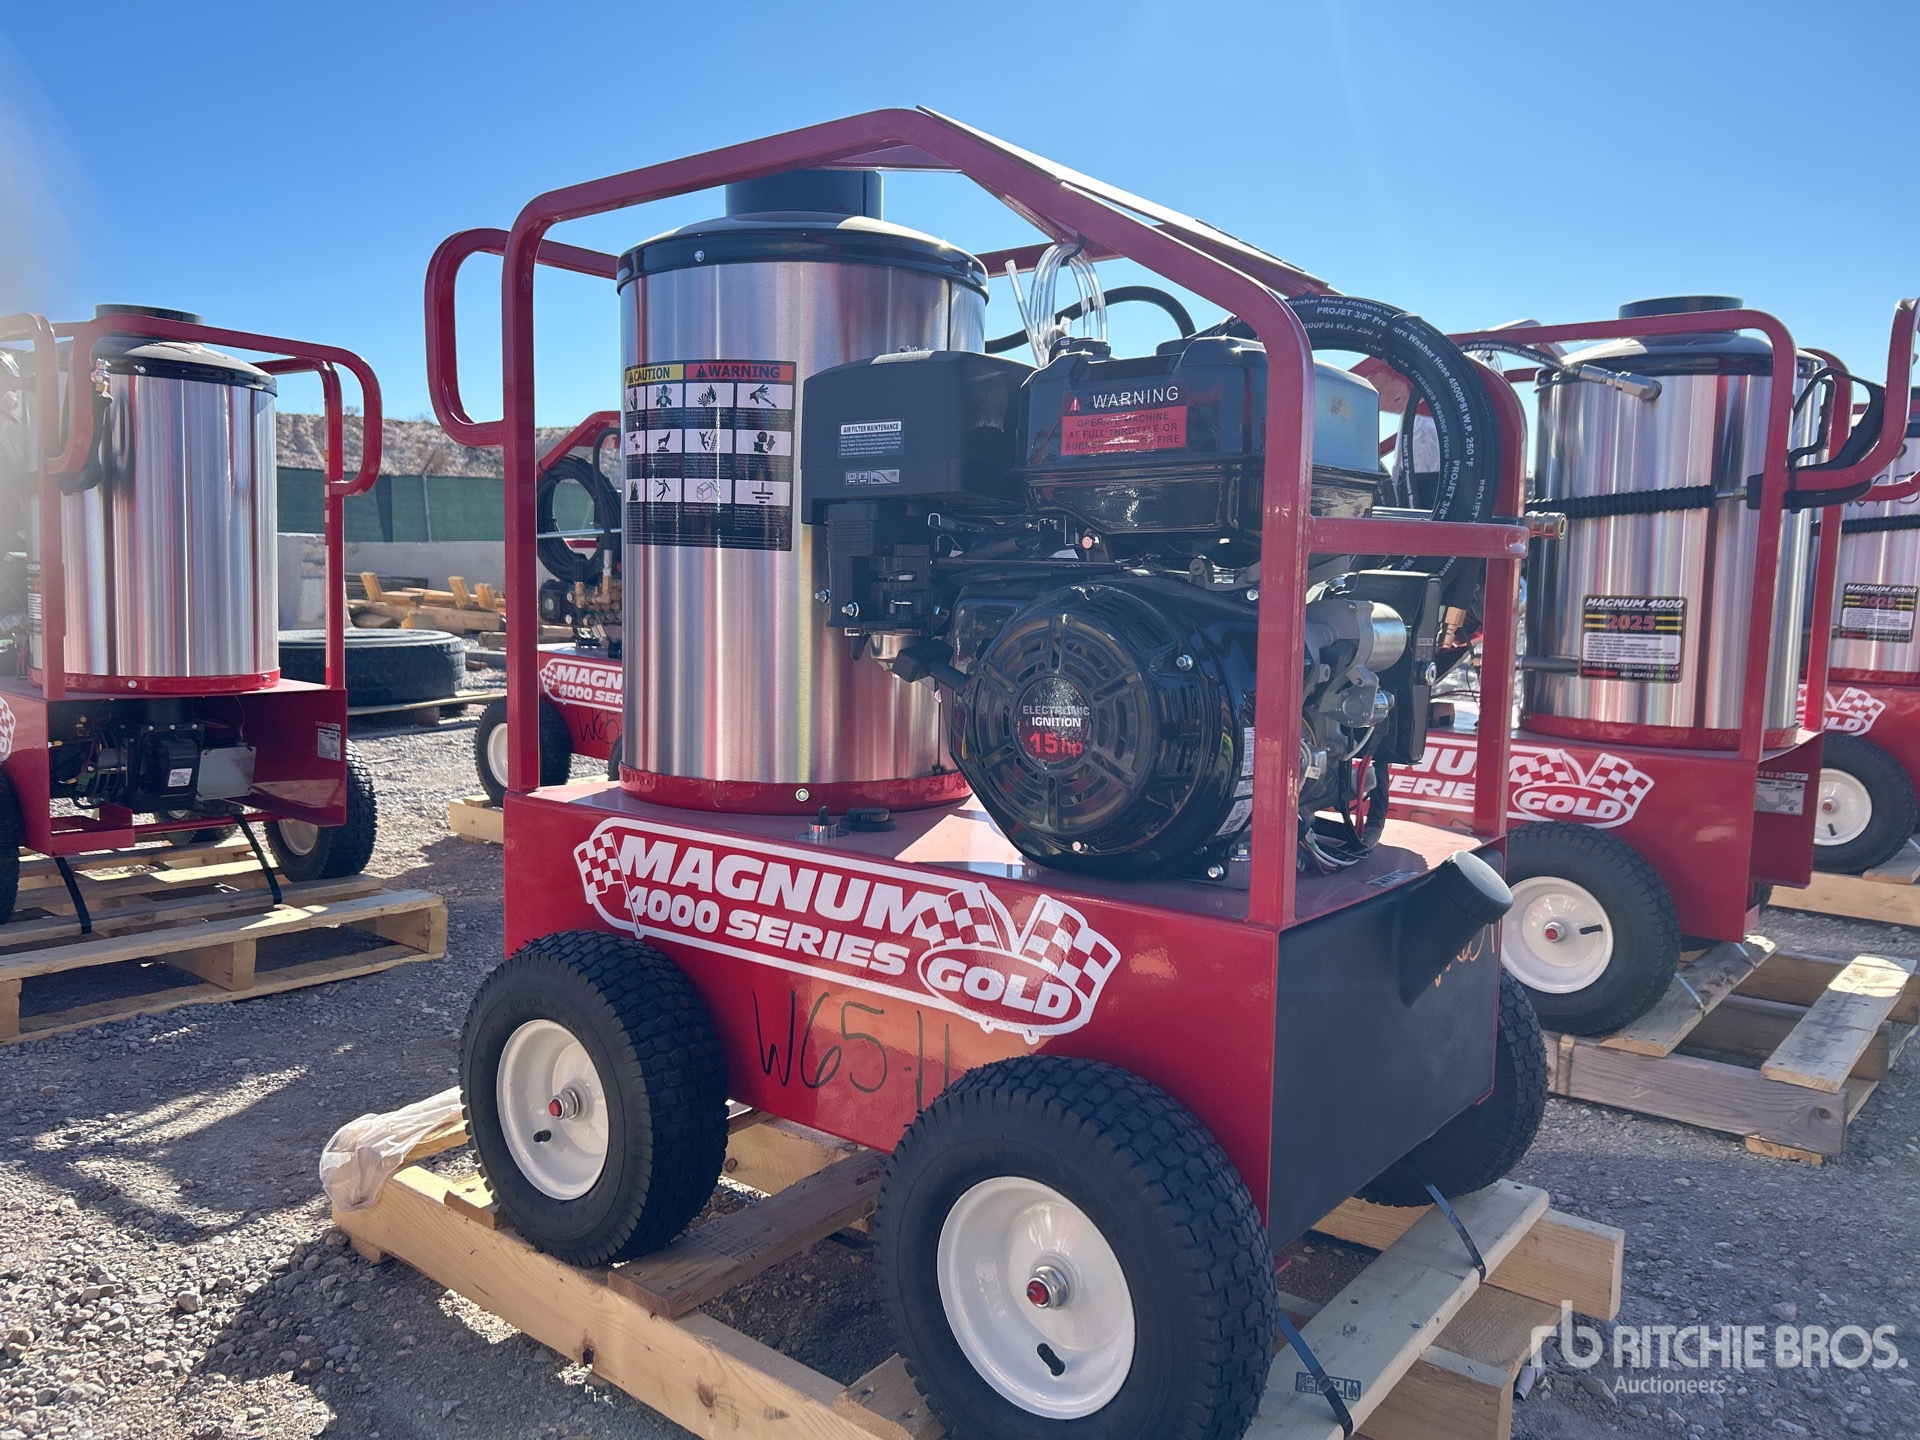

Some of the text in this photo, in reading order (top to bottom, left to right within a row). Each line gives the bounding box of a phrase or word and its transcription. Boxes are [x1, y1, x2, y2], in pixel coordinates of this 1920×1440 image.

[633, 366, 670, 382] CAUTION
[709, 365, 781, 379] WARNING
[1316, 306, 1353, 317] PROJET
[1408, 333, 1436, 359] Washer
[1433, 357, 1450, 378] Hose
[1448, 377, 1470, 413] 4500PSI
[1465, 437, 1475, 455] 250
[1092, 385, 1180, 409] WARNING
[852, 424, 866, 433] FILTER
[867, 422, 899, 432] MAINTENANCE
[1068, 431, 1080, 439] AT
[1082, 430, 1105, 439] FULL
[1163, 422, 1178, 432] OR
[1157, 434, 1180, 445] FIRE
[1445, 459, 1461, 499] PROJET
[1585, 598, 1684, 609] MAGNUM 4000
[1860, 595, 1897, 609] 2025
[1605, 614, 1656, 631] 2025
[559, 683, 593, 700] 4000
[1031, 716, 1081, 727] IGNITION
[1519, 791, 1621, 819] GOLD
[616, 833, 937, 944] MAGNUM
[624, 883, 911, 977] 4000 SERIES
[925, 955, 1073, 1020] GOLD
